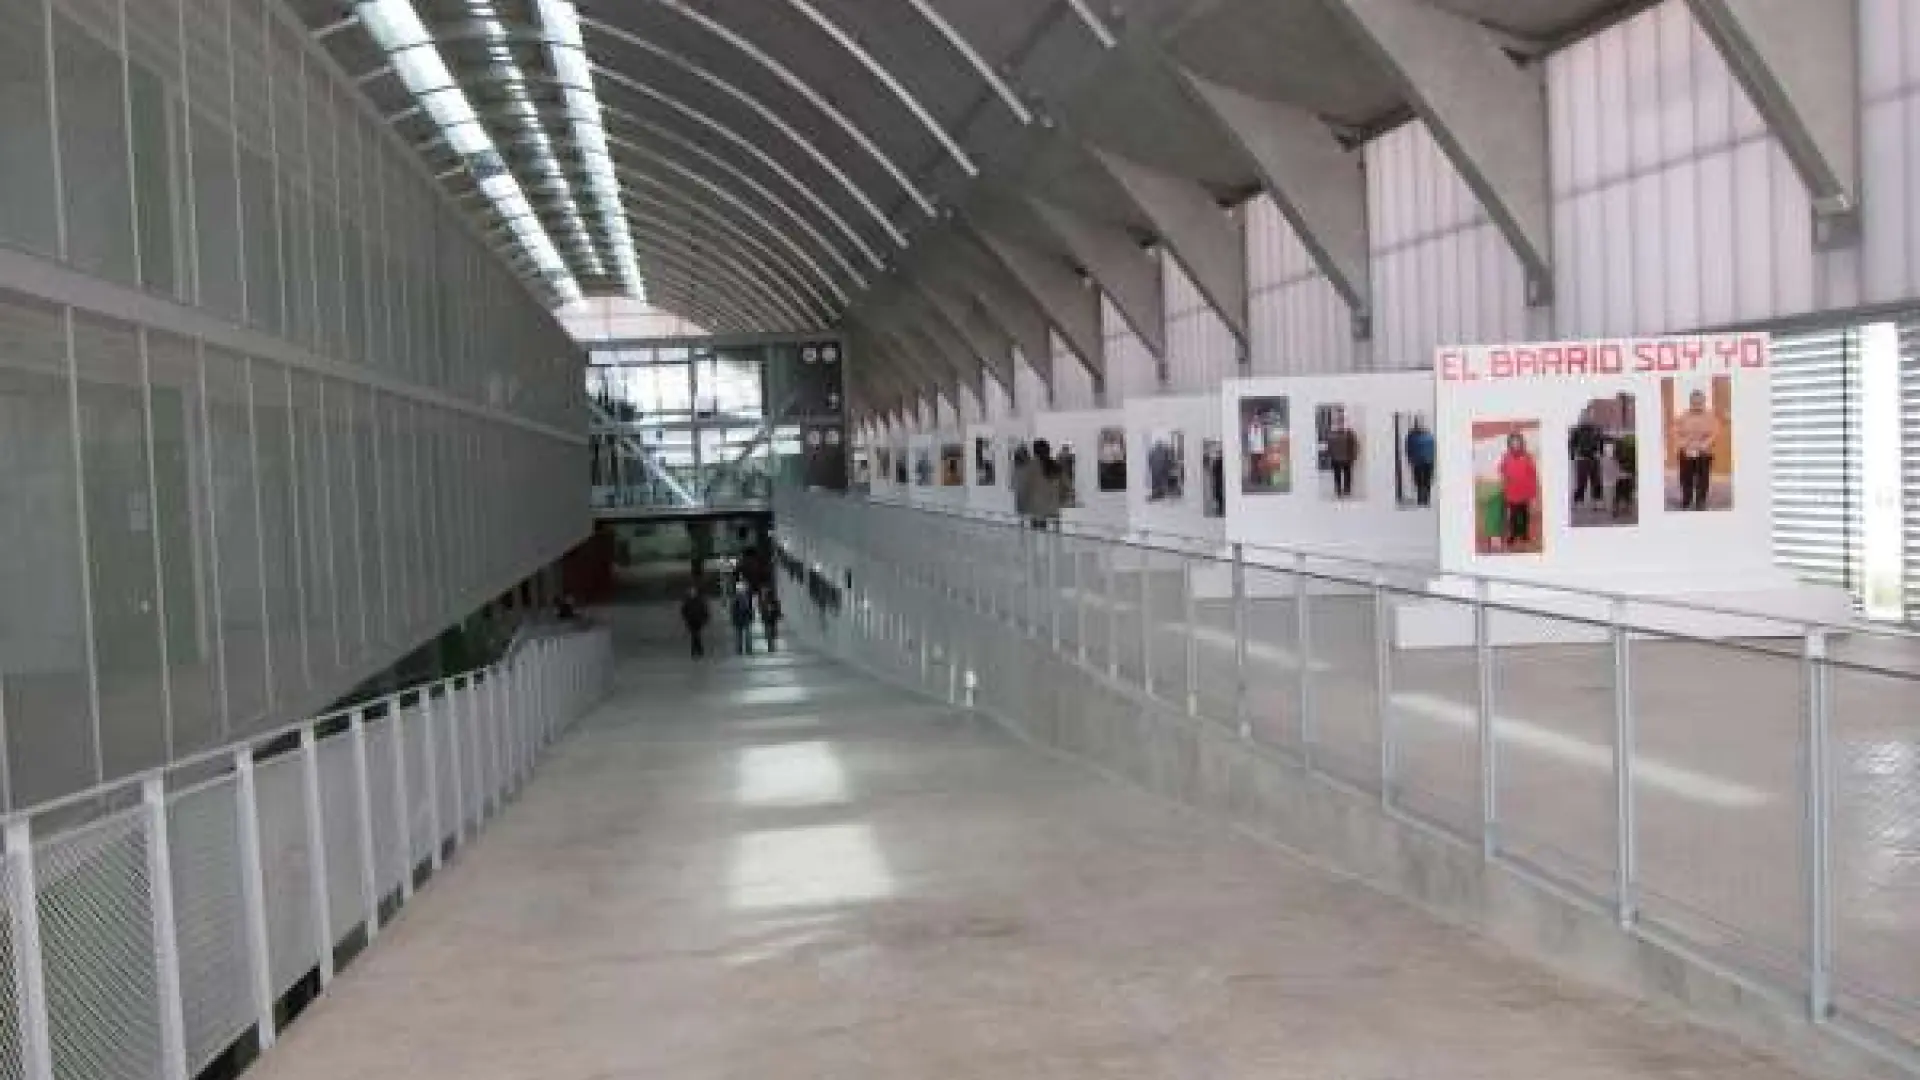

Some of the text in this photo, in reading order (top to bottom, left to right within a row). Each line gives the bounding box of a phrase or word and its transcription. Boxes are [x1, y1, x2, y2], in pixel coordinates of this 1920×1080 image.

[1440, 337, 1763, 379] EL BARRIO SOY YO
